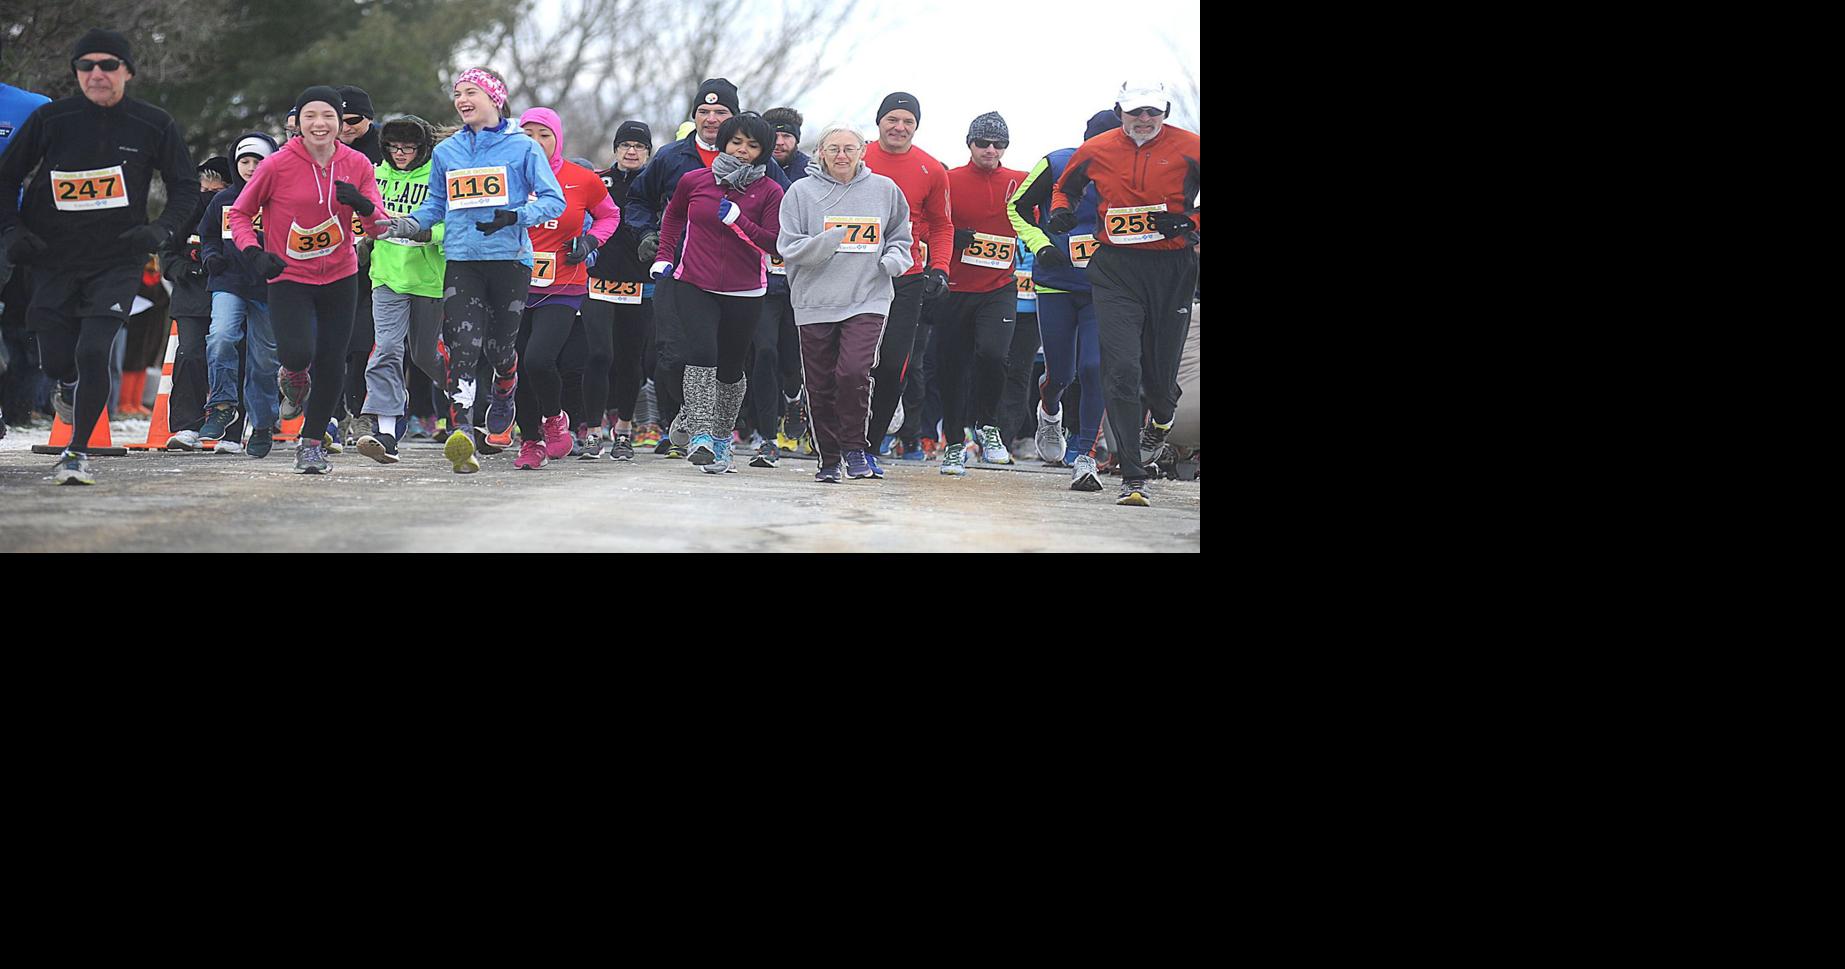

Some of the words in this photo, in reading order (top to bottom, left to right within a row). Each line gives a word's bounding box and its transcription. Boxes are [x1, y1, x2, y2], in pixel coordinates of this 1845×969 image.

[59, 177, 115, 199] 247
[452, 176, 500, 198] 116
[1111, 212, 1157, 234] 258
[298, 231, 330, 250] 39
[836, 224, 876, 242] 74
[969, 241, 1010, 259] 535
[593, 279, 637, 295] 423
